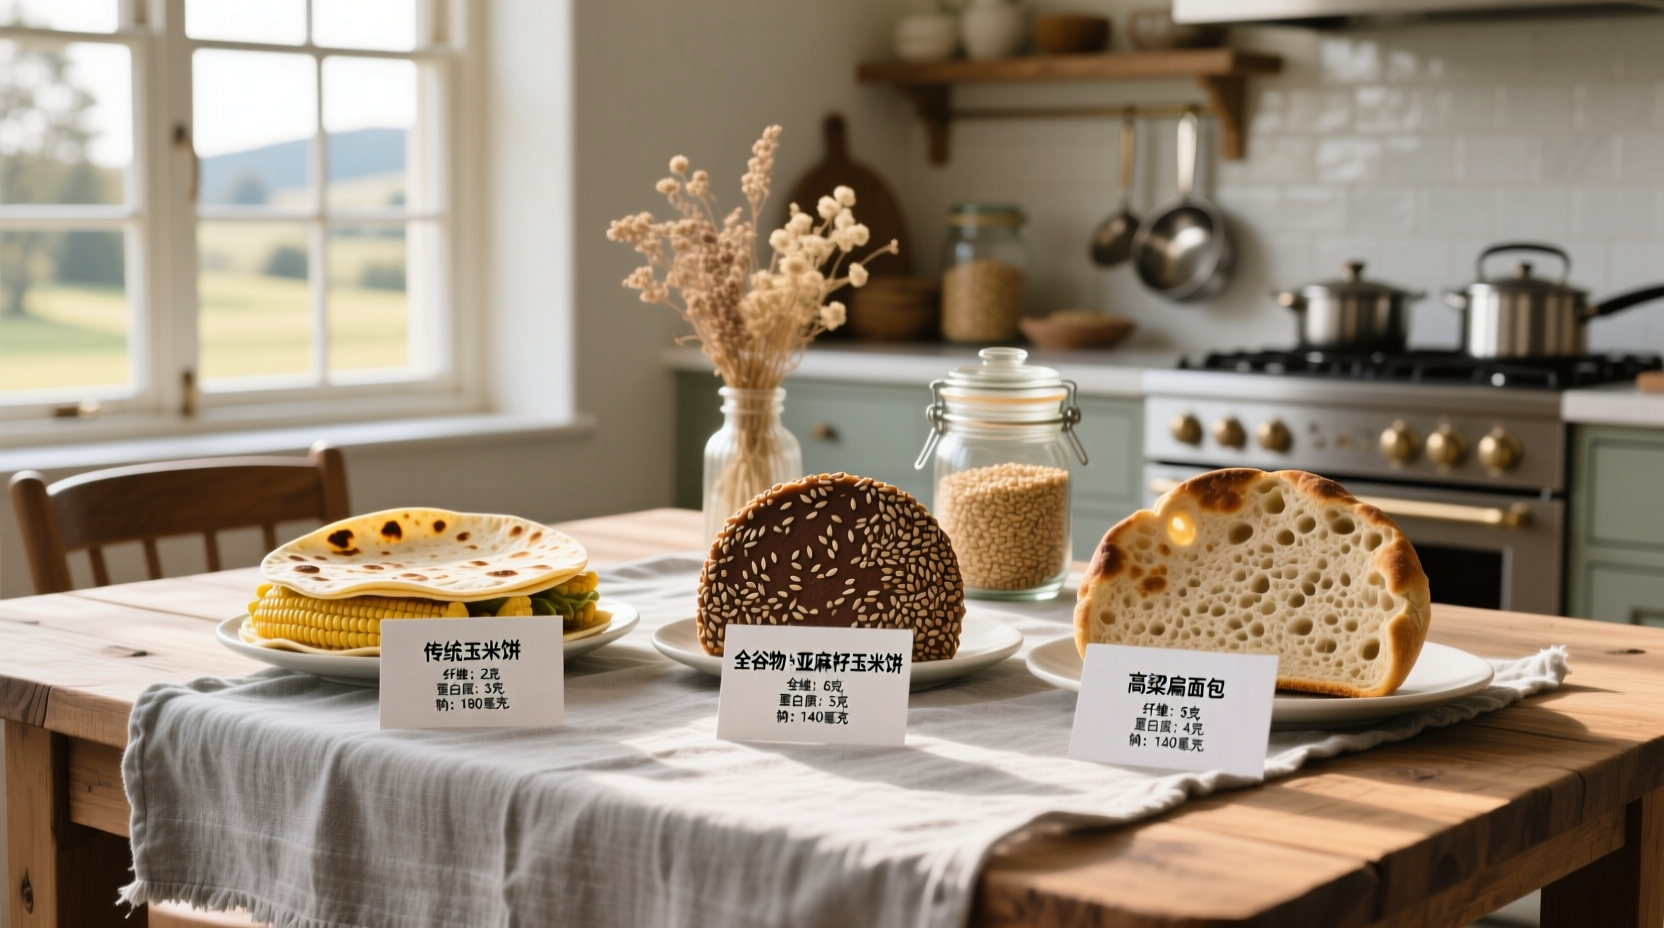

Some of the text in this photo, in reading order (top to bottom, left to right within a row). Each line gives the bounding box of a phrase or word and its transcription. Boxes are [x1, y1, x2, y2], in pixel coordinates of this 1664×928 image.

[424, 639, 521, 662] 传统玉米饼
